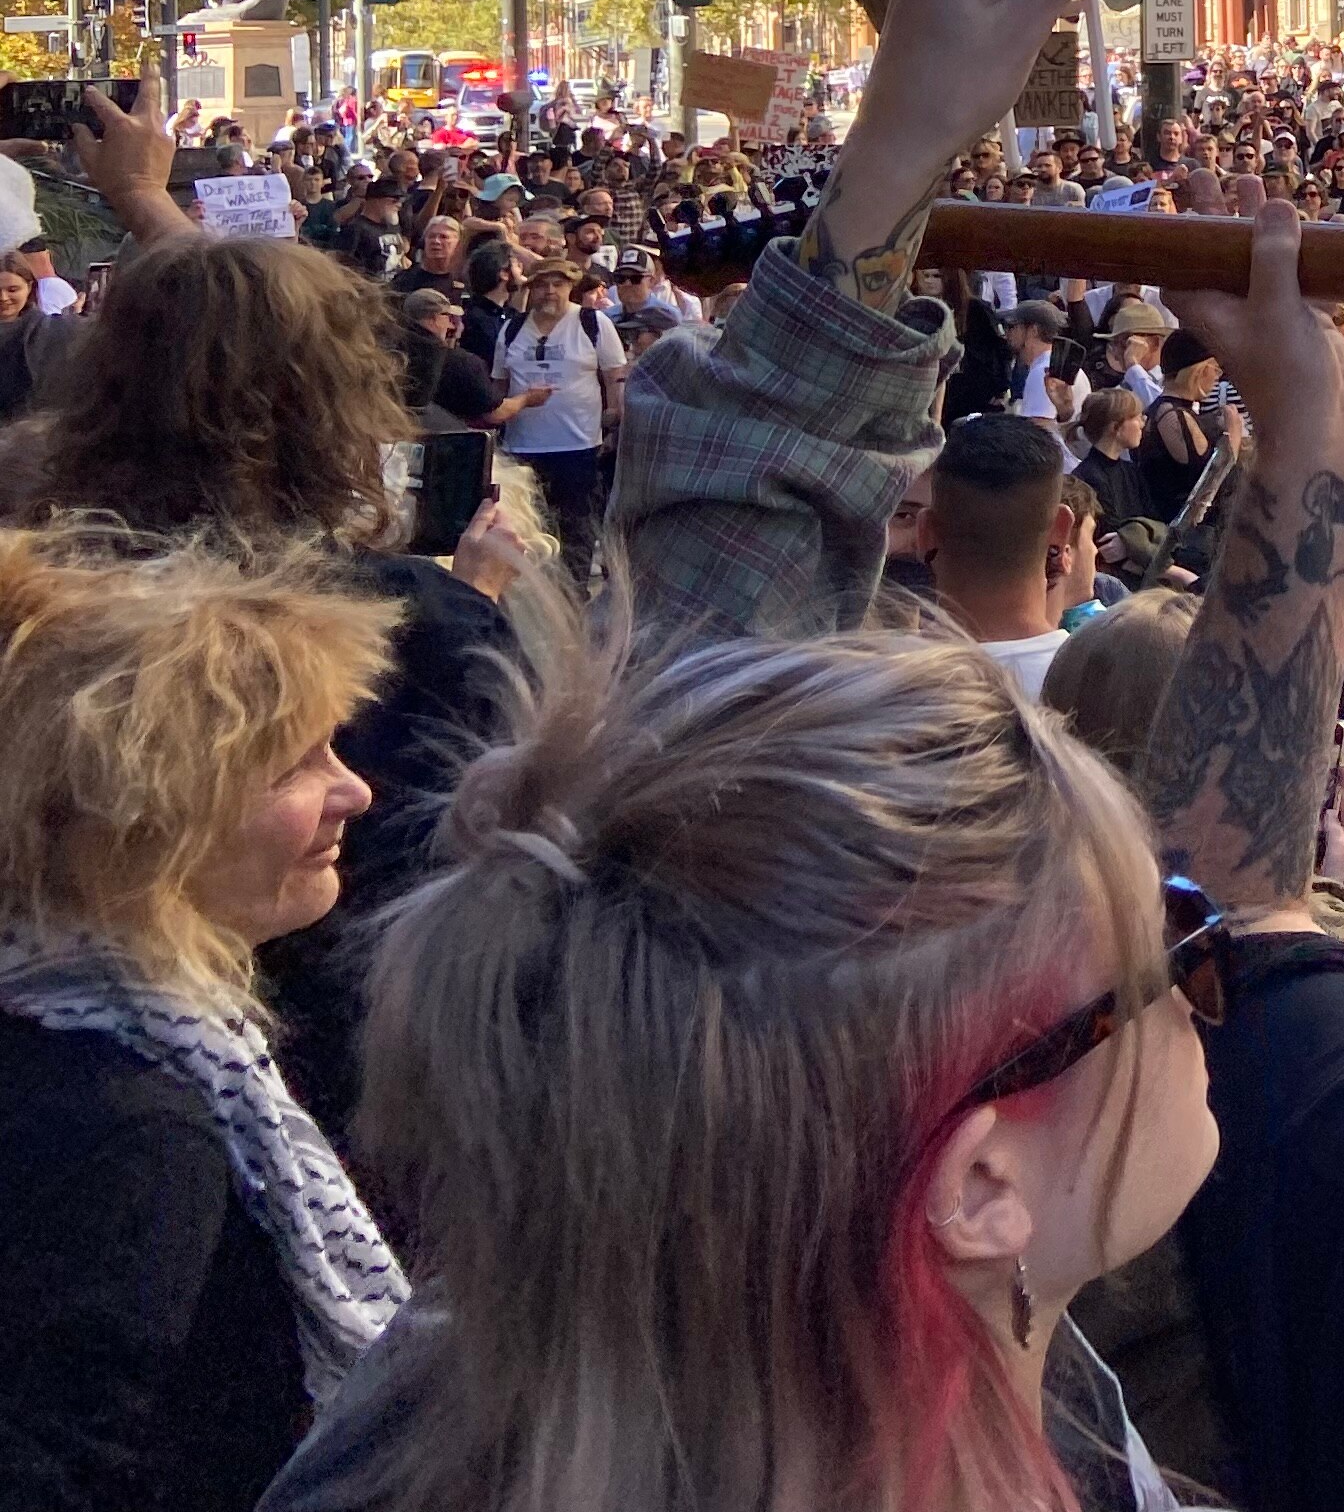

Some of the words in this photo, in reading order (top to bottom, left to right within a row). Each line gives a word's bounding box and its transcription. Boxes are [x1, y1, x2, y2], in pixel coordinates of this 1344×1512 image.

[1156, 12, 1183, 22] MUST
[1156, 27, 1184, 37] TURN
[1154, 42, 1185, 53] LEFT
[226, 190, 277, 207] WANKER
